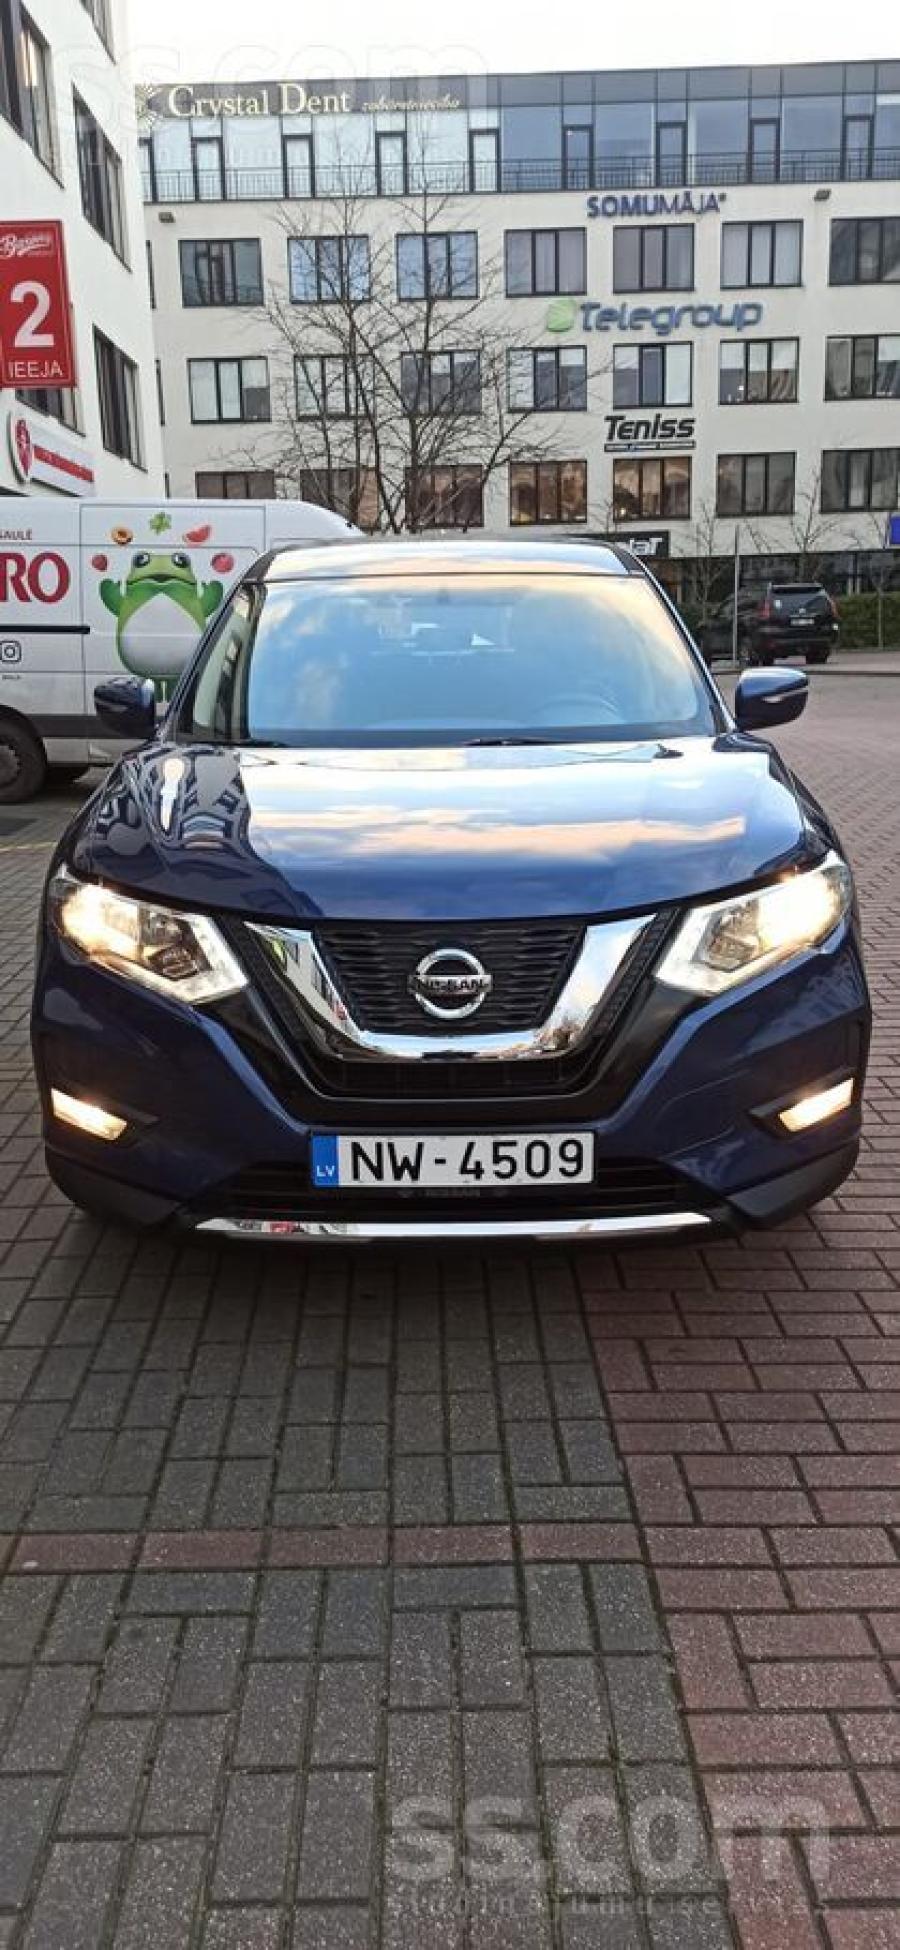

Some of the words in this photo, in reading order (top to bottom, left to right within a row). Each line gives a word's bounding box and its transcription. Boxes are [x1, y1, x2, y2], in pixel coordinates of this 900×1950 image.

[168, 86, 270, 119] Crystal
[279, 83, 351, 114] Dent
[10, 280, 55, 348] 2
[580, 301, 764, 336] Telegroup
[7, 360, 64, 379] IEEJA
[316, 1165, 335, 1177] LV
